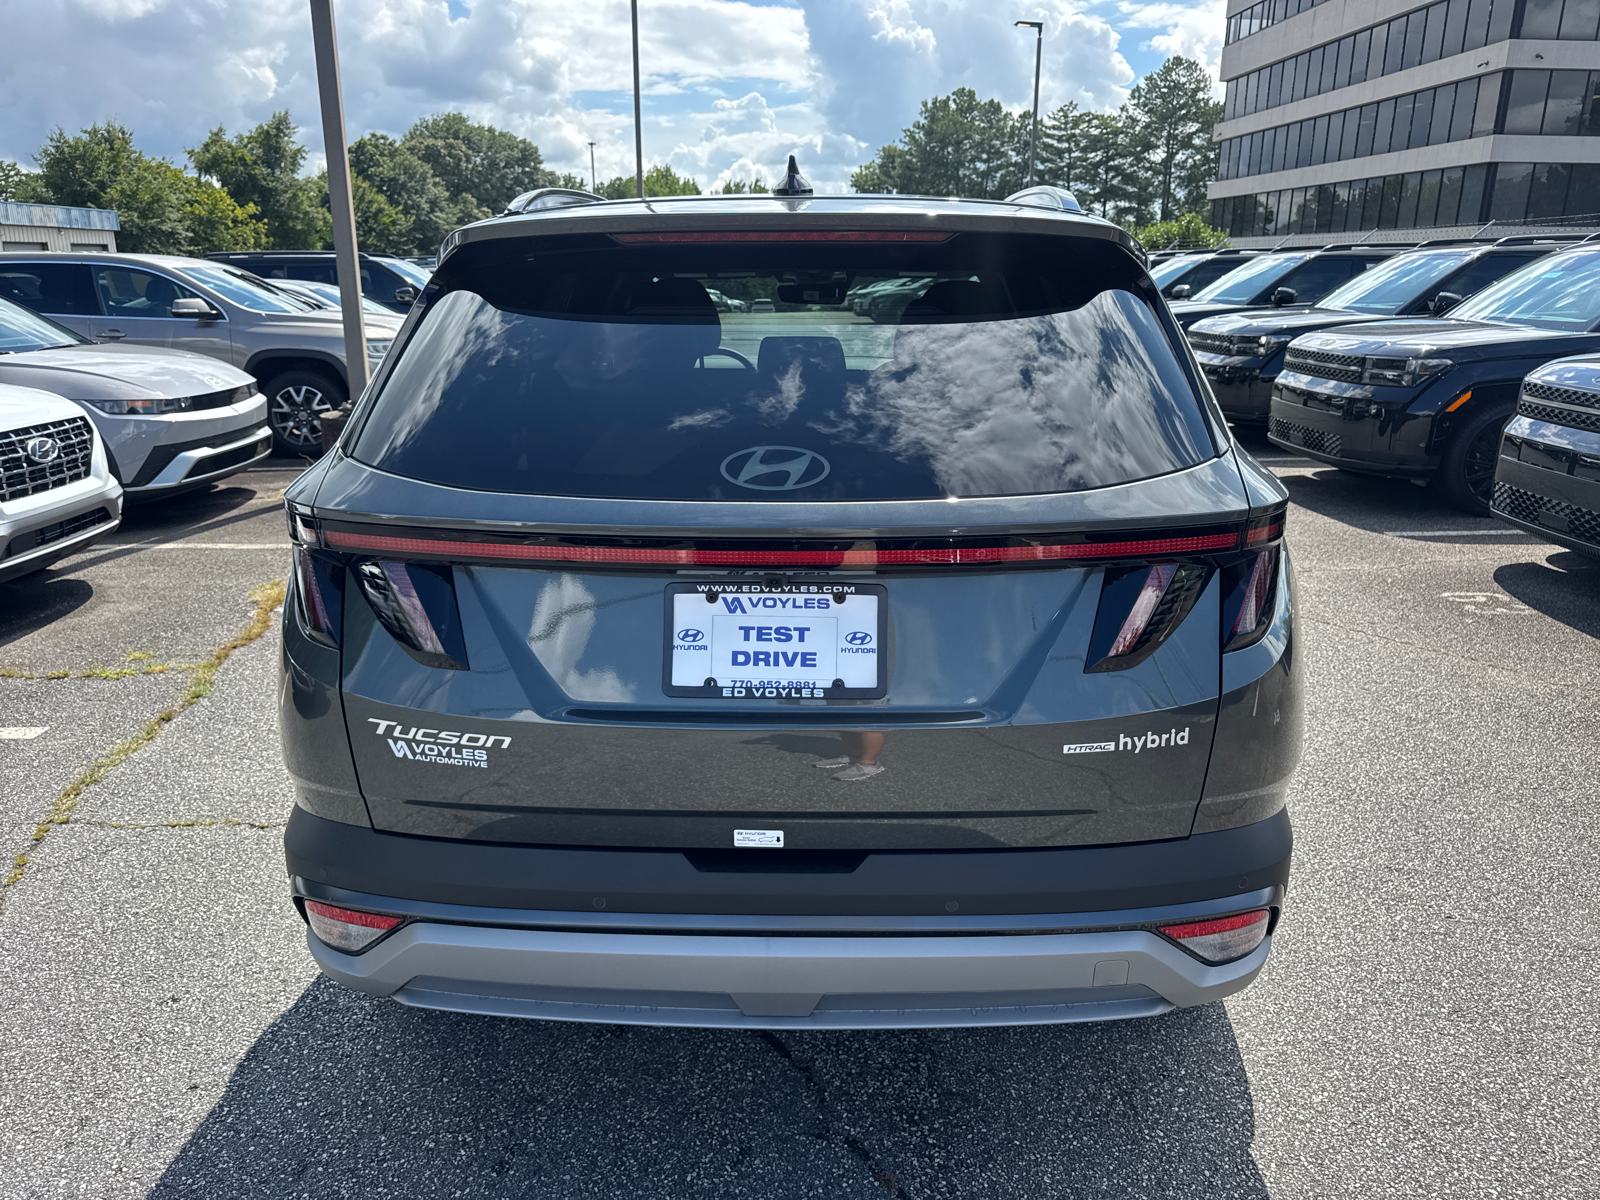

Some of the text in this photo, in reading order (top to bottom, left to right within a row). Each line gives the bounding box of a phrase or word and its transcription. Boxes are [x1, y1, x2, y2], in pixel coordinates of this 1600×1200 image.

[748, 597, 831, 609] VOYLES
[738, 626, 811, 642] TEST
[731, 651, 818, 667] DRIVE
[722, 688, 824, 697] ED VOYLES
[1067, 727, 1190, 754] HTRAC hybrid
[411, 742, 488, 761] VOYLES
[414, 754, 488, 768] AUTOMOTIVE
